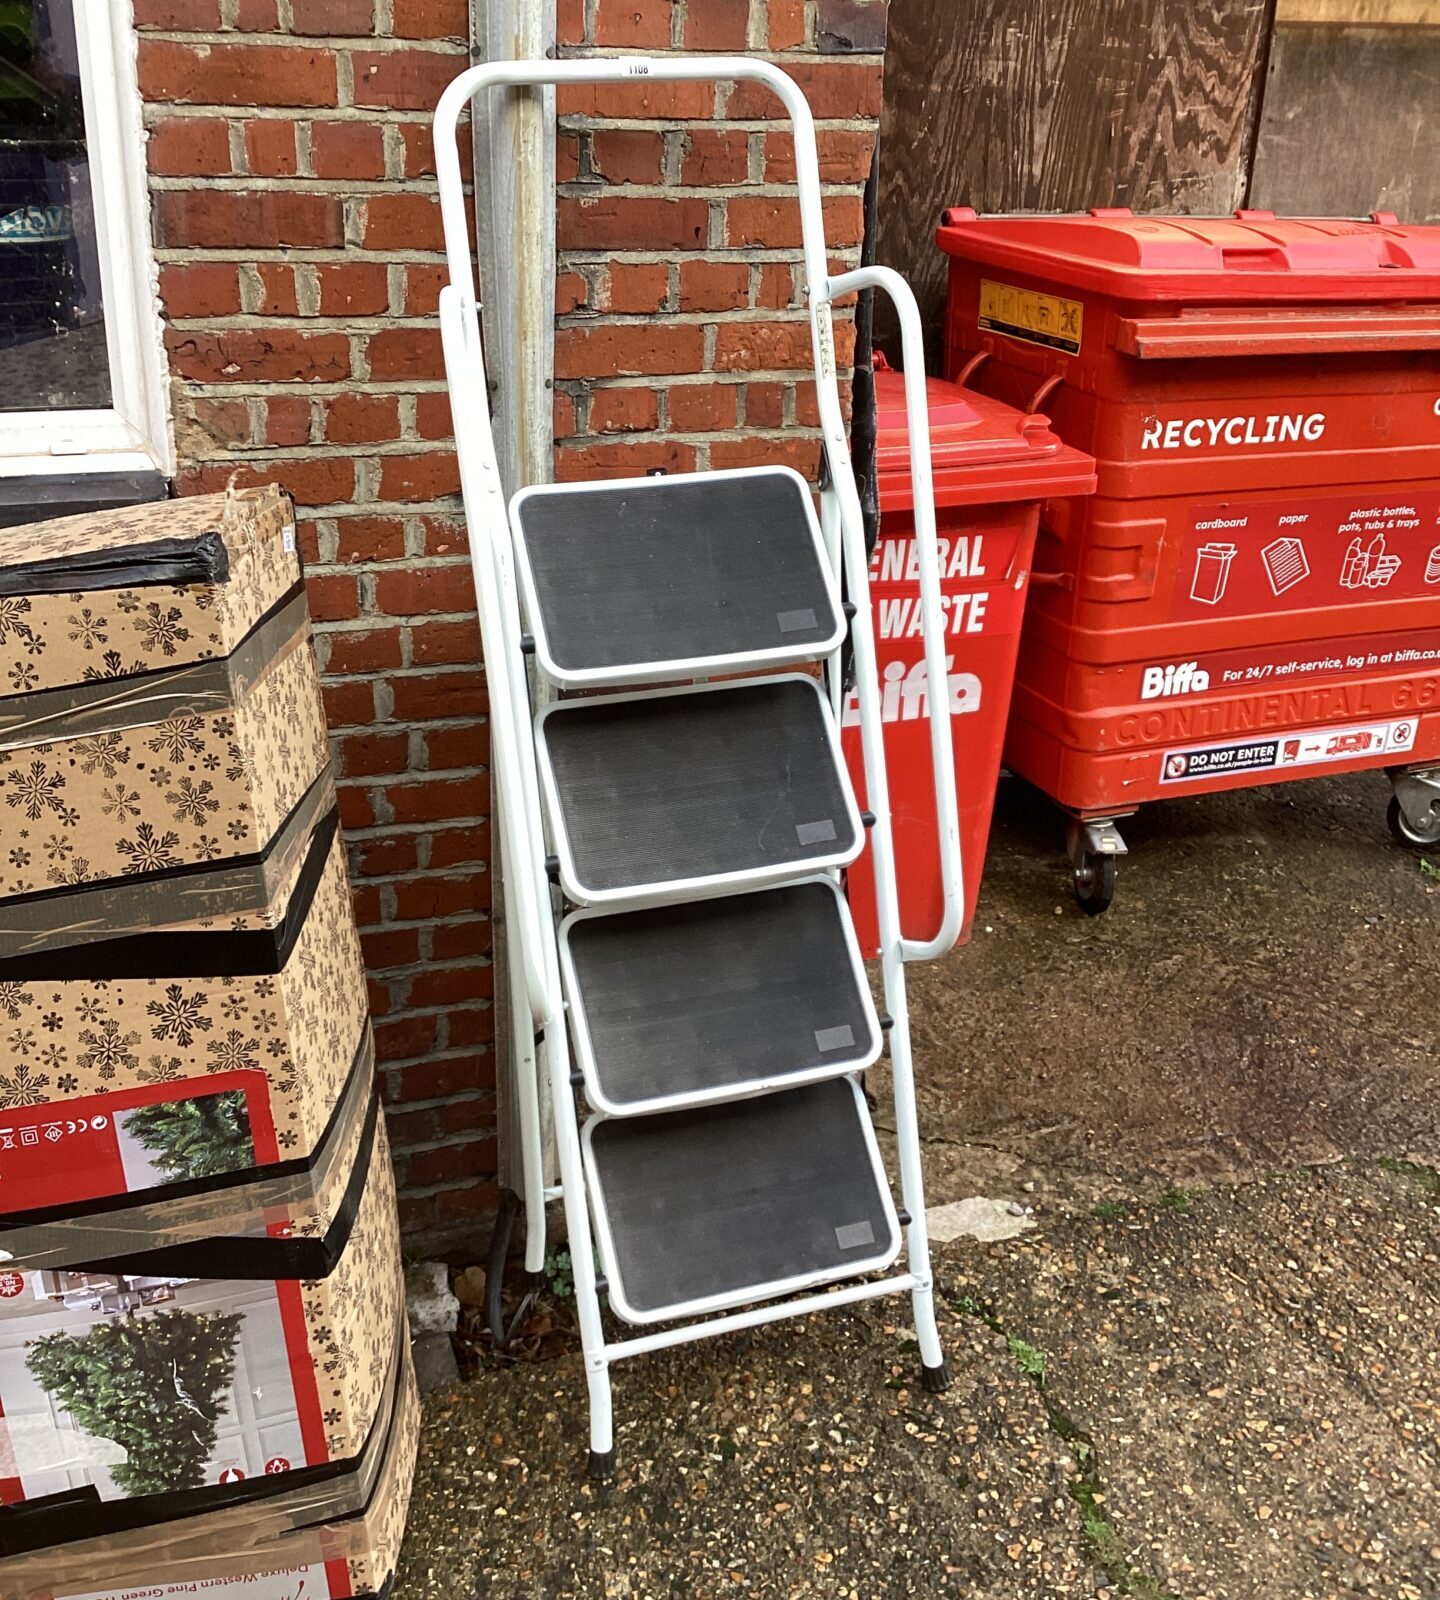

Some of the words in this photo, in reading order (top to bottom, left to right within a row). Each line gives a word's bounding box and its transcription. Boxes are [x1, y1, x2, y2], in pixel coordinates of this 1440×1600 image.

[1141, 413, 1325, 449] RECYCLING
[1278, 513, 1309, 526] paper
[1349, 507, 1381, 520] plastic
[1383, 506, 1416, 518] bottles,
[1195, 517, 1248, 530] cardboard
[1338, 522, 1362, 534] pots,
[1364, 520, 1384, 531] tubs
[1386, 520, 1394, 528] &
[1396, 518, 1420, 530] trays
[868, 535, 986, 582] ENERAL
[1223, 670, 1243, 682] For
[1245, 664, 1274, 678] 24/7
[1275, 657, 1344, 675] self-service,
[1346, 655, 1365, 668] log
[1367, 653, 1378, 664] in
[1380, 652, 1393, 663] at
[1141, 661, 1209, 699] Biffa
[1115, 684, 1371, 745] CONTINENTAL
[1190, 755, 1208, 766] DO
[1210, 750, 1236, 763] NOT
[1237, 745, 1275, 760] ENTER
[168, 1583, 198, 1592] Pine
[201, 1573, 258, 1588] Western
[121, 1588, 164, 1600] Green
